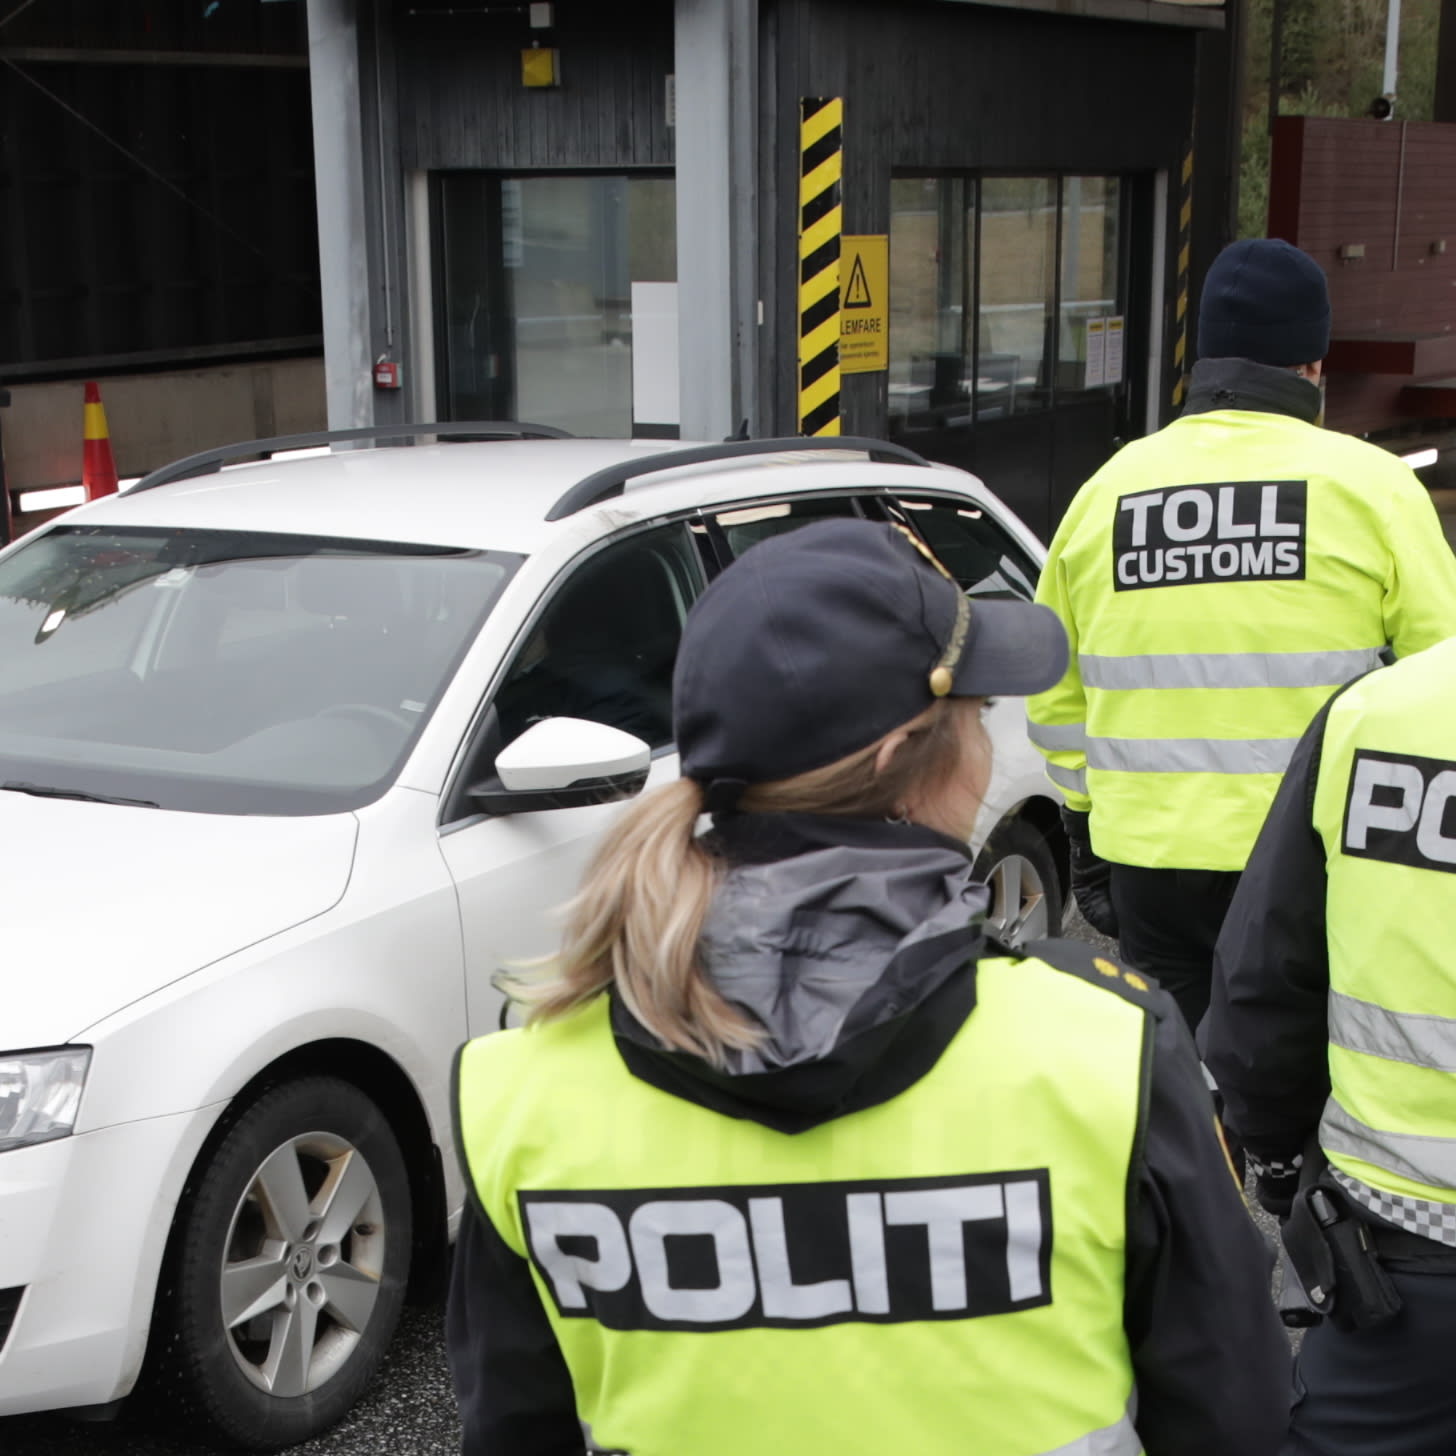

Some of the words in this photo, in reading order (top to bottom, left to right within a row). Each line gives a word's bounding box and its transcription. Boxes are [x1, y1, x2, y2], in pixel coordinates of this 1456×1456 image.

[840, 318, 881, 336] LEMFARE
[1120, 485, 1300, 547] TOLL
[1117, 541, 1300, 585] CUSTOMS
[525, 1180, 1043, 1323] POLITI
